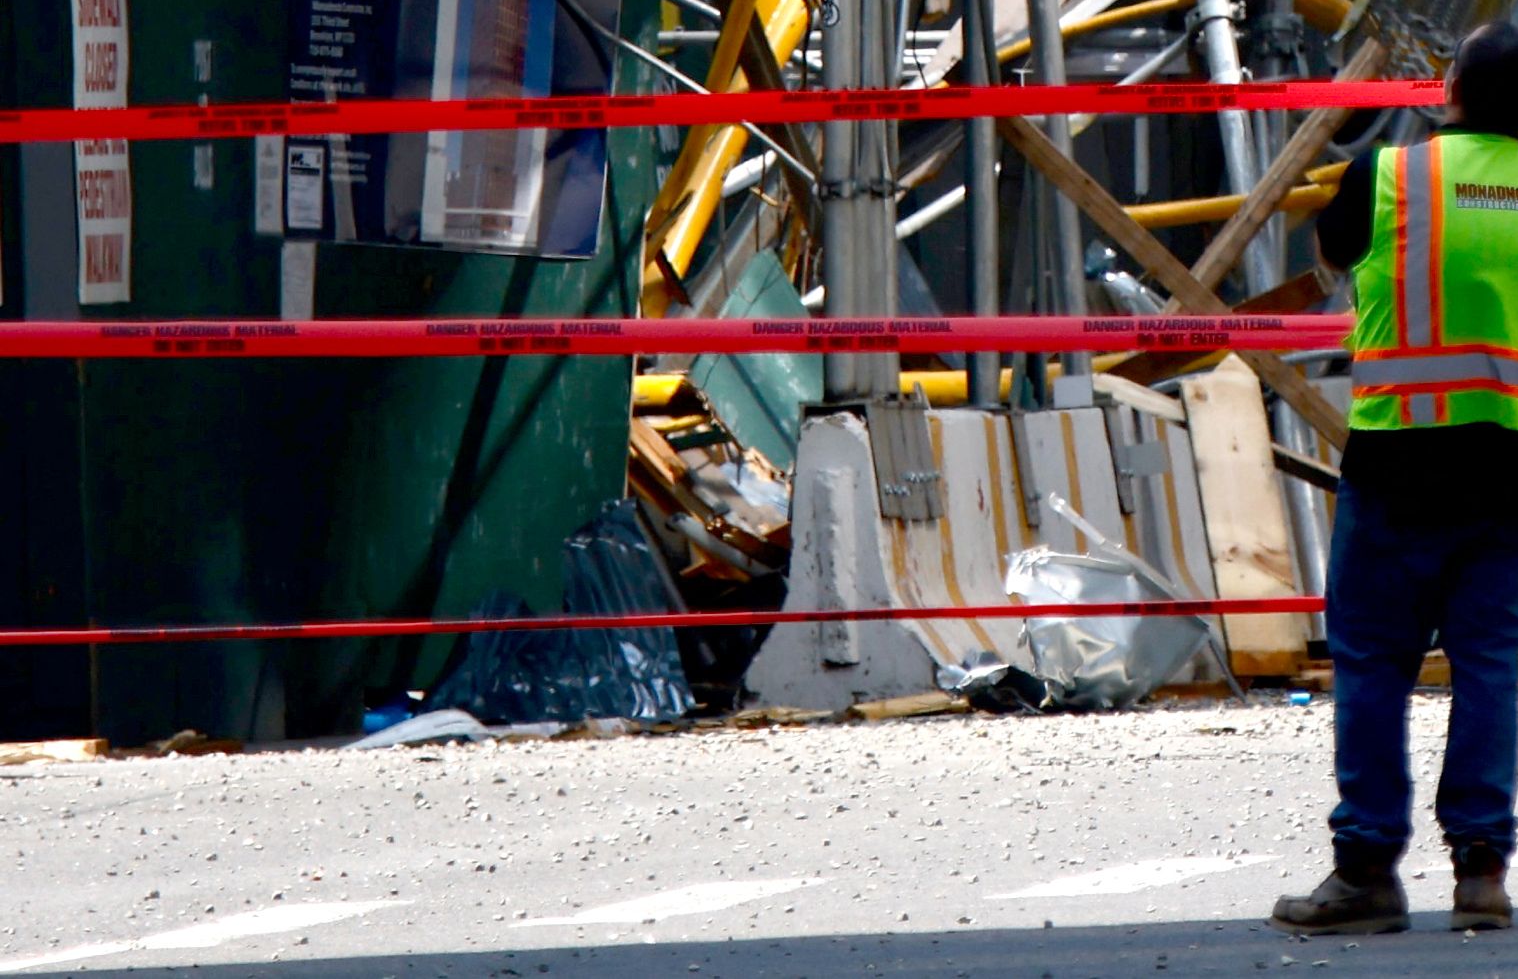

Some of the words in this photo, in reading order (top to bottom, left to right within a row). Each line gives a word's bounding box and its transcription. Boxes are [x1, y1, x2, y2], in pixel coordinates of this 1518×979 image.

[753, 322, 803, 334] DANGER
[808, 322, 883, 334] HAZARDOUS
[889, 322, 952, 334] MATERIAL
[1083, 318, 1134, 331] DANGER
[1139, 318, 1215, 331] HAZARDOUS
[1220, 318, 1285, 331] MATERIAL
[1137, 333, 1155, 346] DO
[1161, 333, 1186, 346] NOT
[1190, 333, 1229, 346] ENTER
